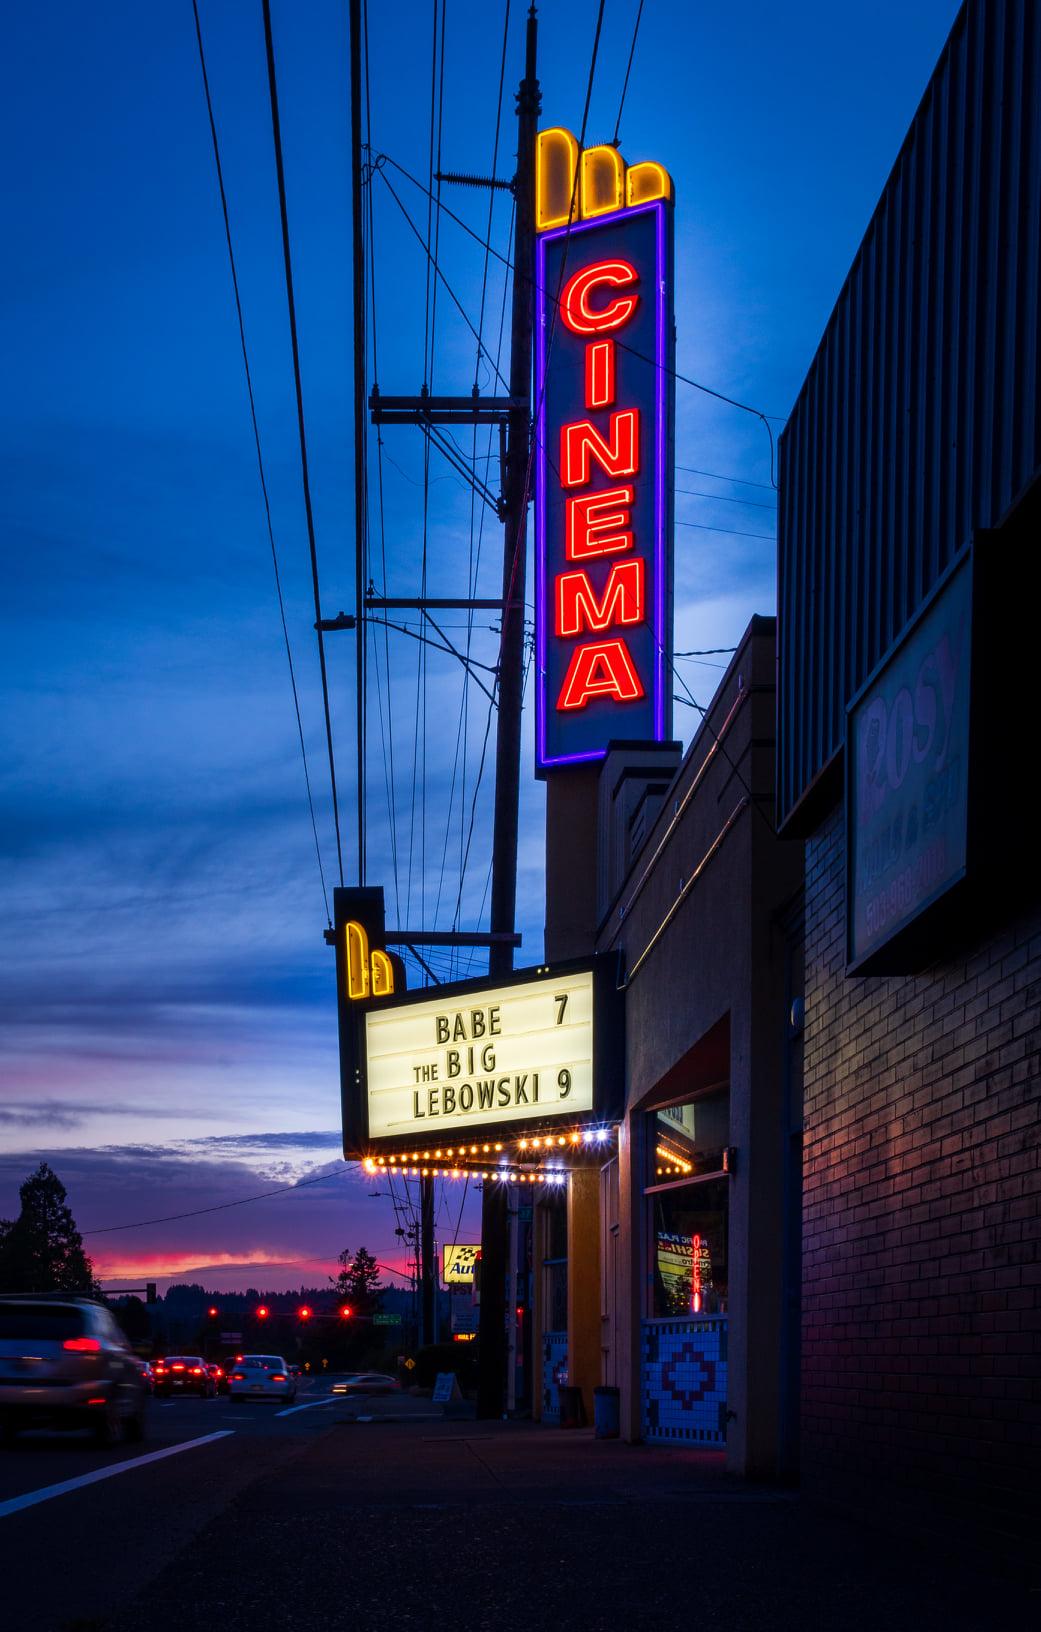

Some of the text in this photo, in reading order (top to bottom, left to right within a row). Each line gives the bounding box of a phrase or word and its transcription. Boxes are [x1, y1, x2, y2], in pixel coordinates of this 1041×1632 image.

[556, 258, 646, 713] CINEMA
[435, 993, 569, 1045] BABE 7
[412, 1043, 496, 1083] THE BIG
[413, 1068, 572, 1119] LEBOWSKI 9
